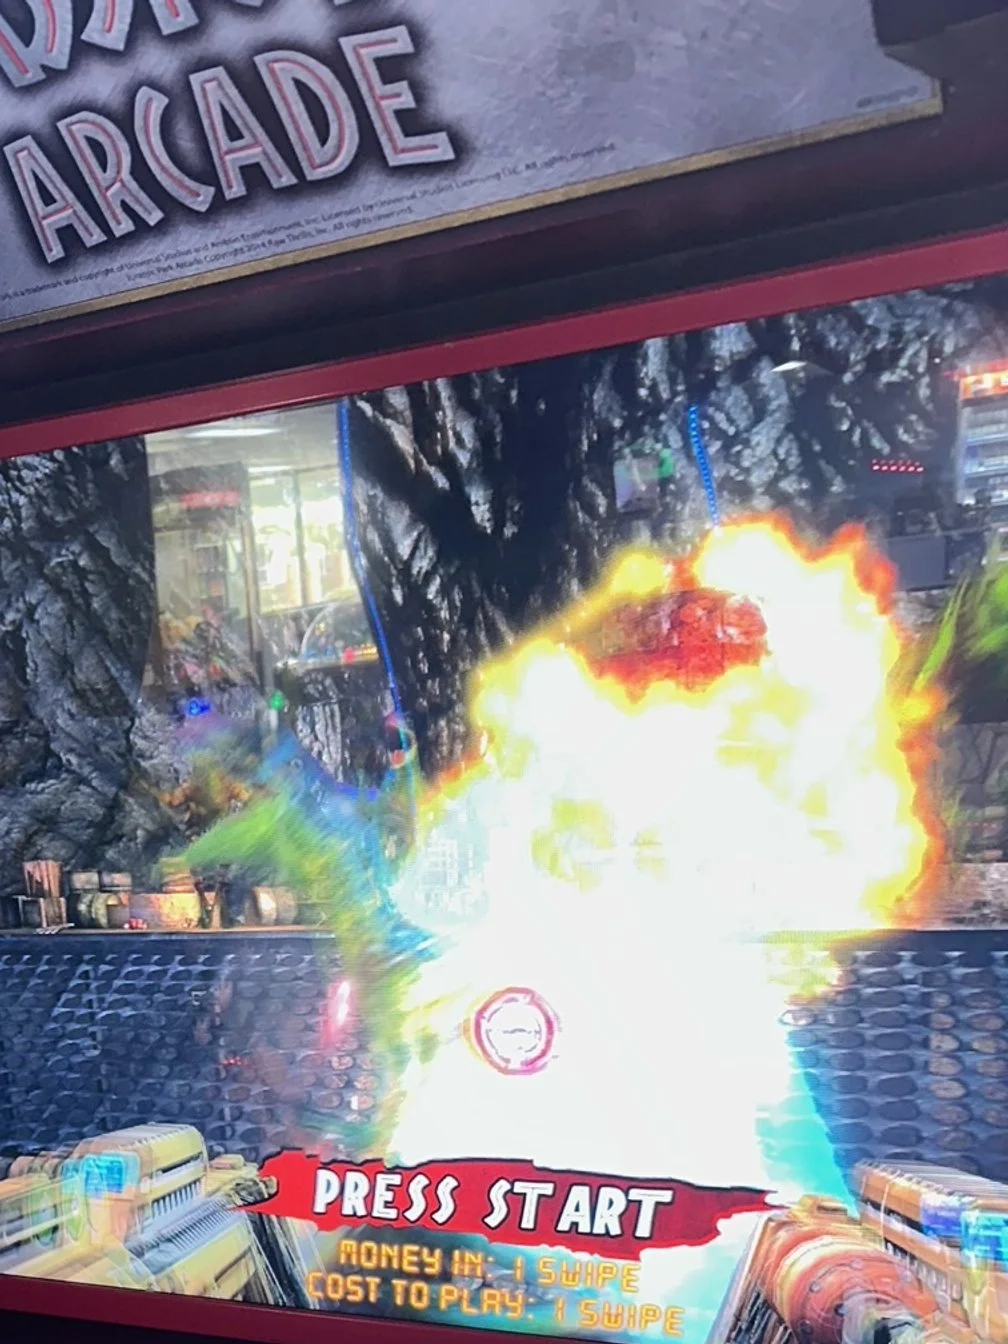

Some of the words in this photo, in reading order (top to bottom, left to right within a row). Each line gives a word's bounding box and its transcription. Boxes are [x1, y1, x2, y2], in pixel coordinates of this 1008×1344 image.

[2, 25, 455, 264] ARCADE
[311, 1167, 460, 1226] PRESS
[482, 1178, 675, 1240] START
[337, 1238, 442, 1277] MONEY
[451, 1249, 495, 1281] IN:
[537, 1257, 641, 1293] SWIPE
[306, 1271, 382, 1304] COST
[392, 1278, 429, 1309] TO
[438, 1284, 536, 1321] PLAY:
[577, 1301, 687, 1337] SWIPE
